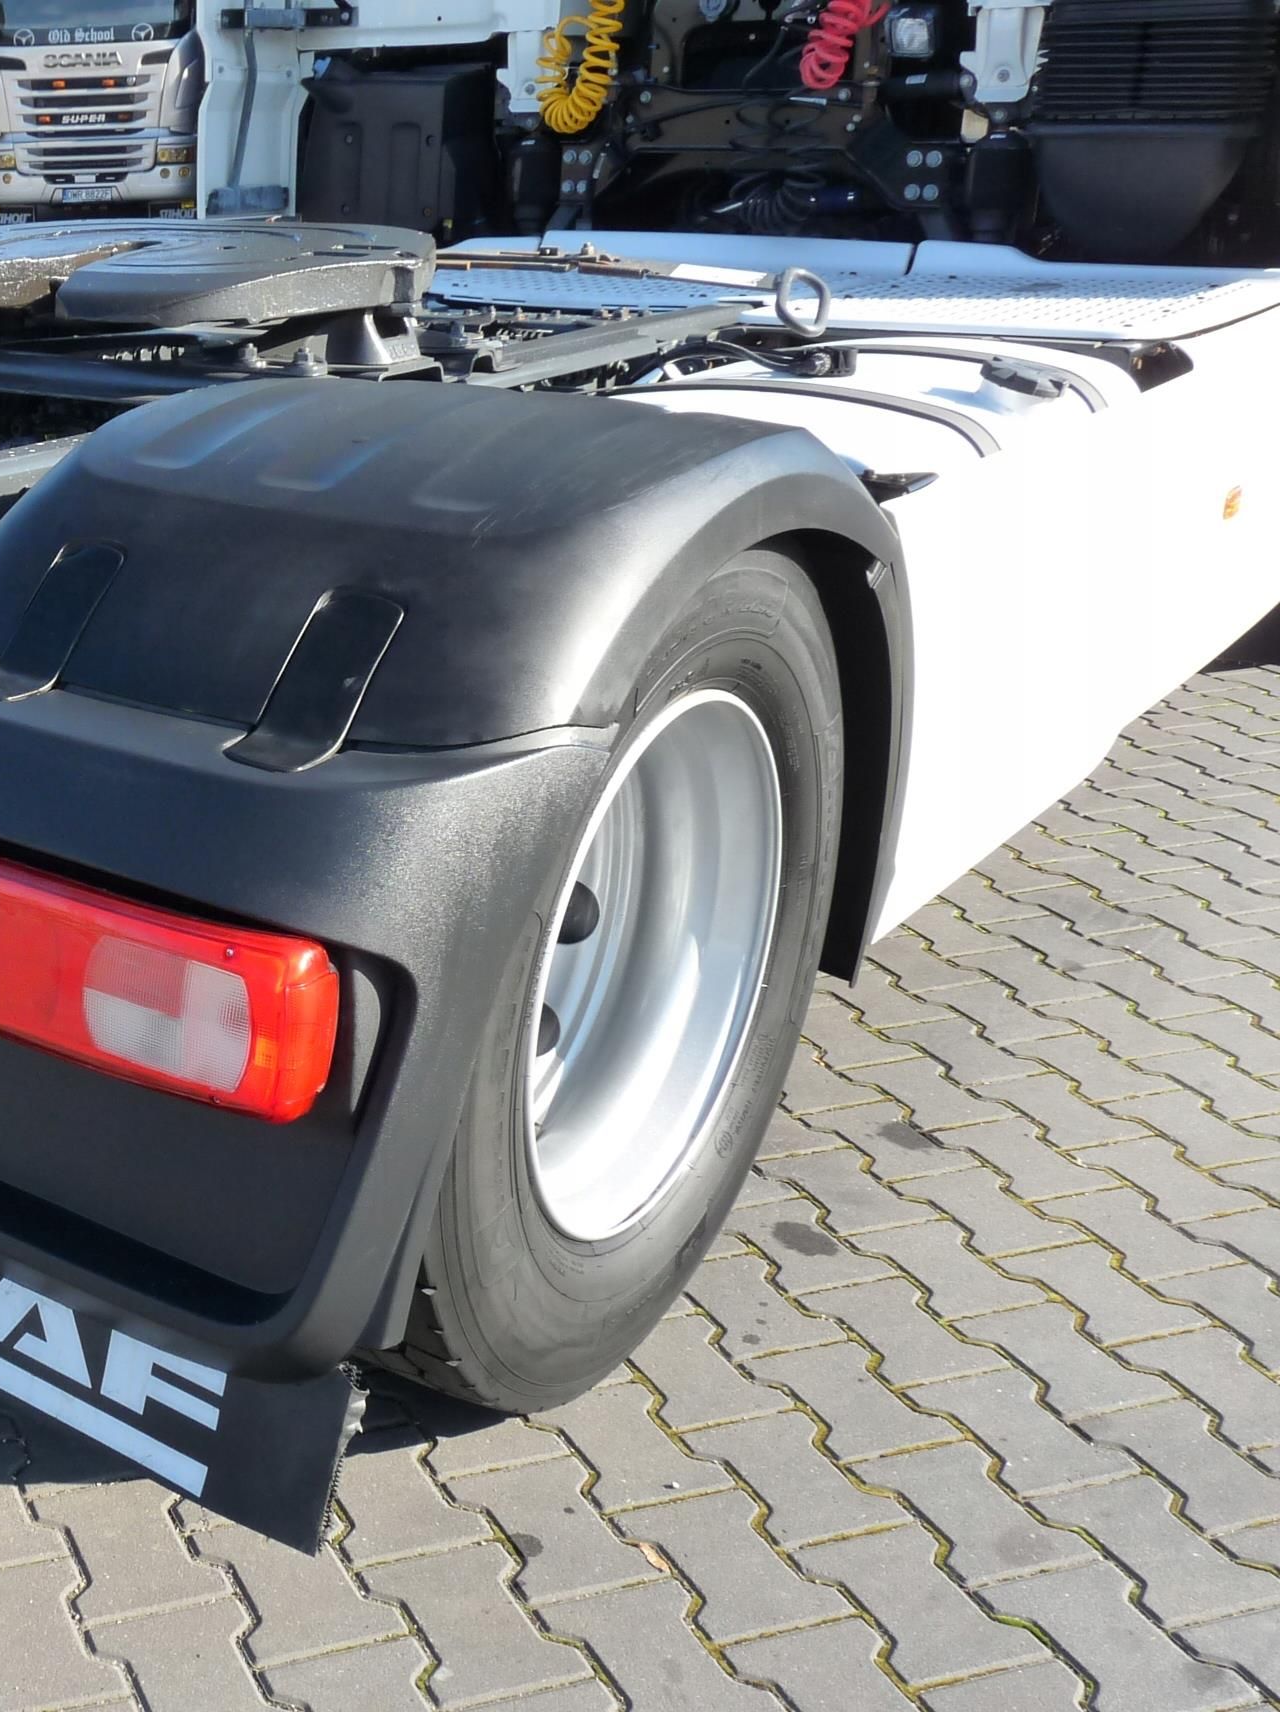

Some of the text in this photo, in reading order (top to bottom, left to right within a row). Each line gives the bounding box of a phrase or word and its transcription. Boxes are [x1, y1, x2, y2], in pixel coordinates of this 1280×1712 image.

[48, 26, 115, 44] Old School
[43, 51, 123, 68] SCANIA
[62, 113, 106, 124] SUPER
